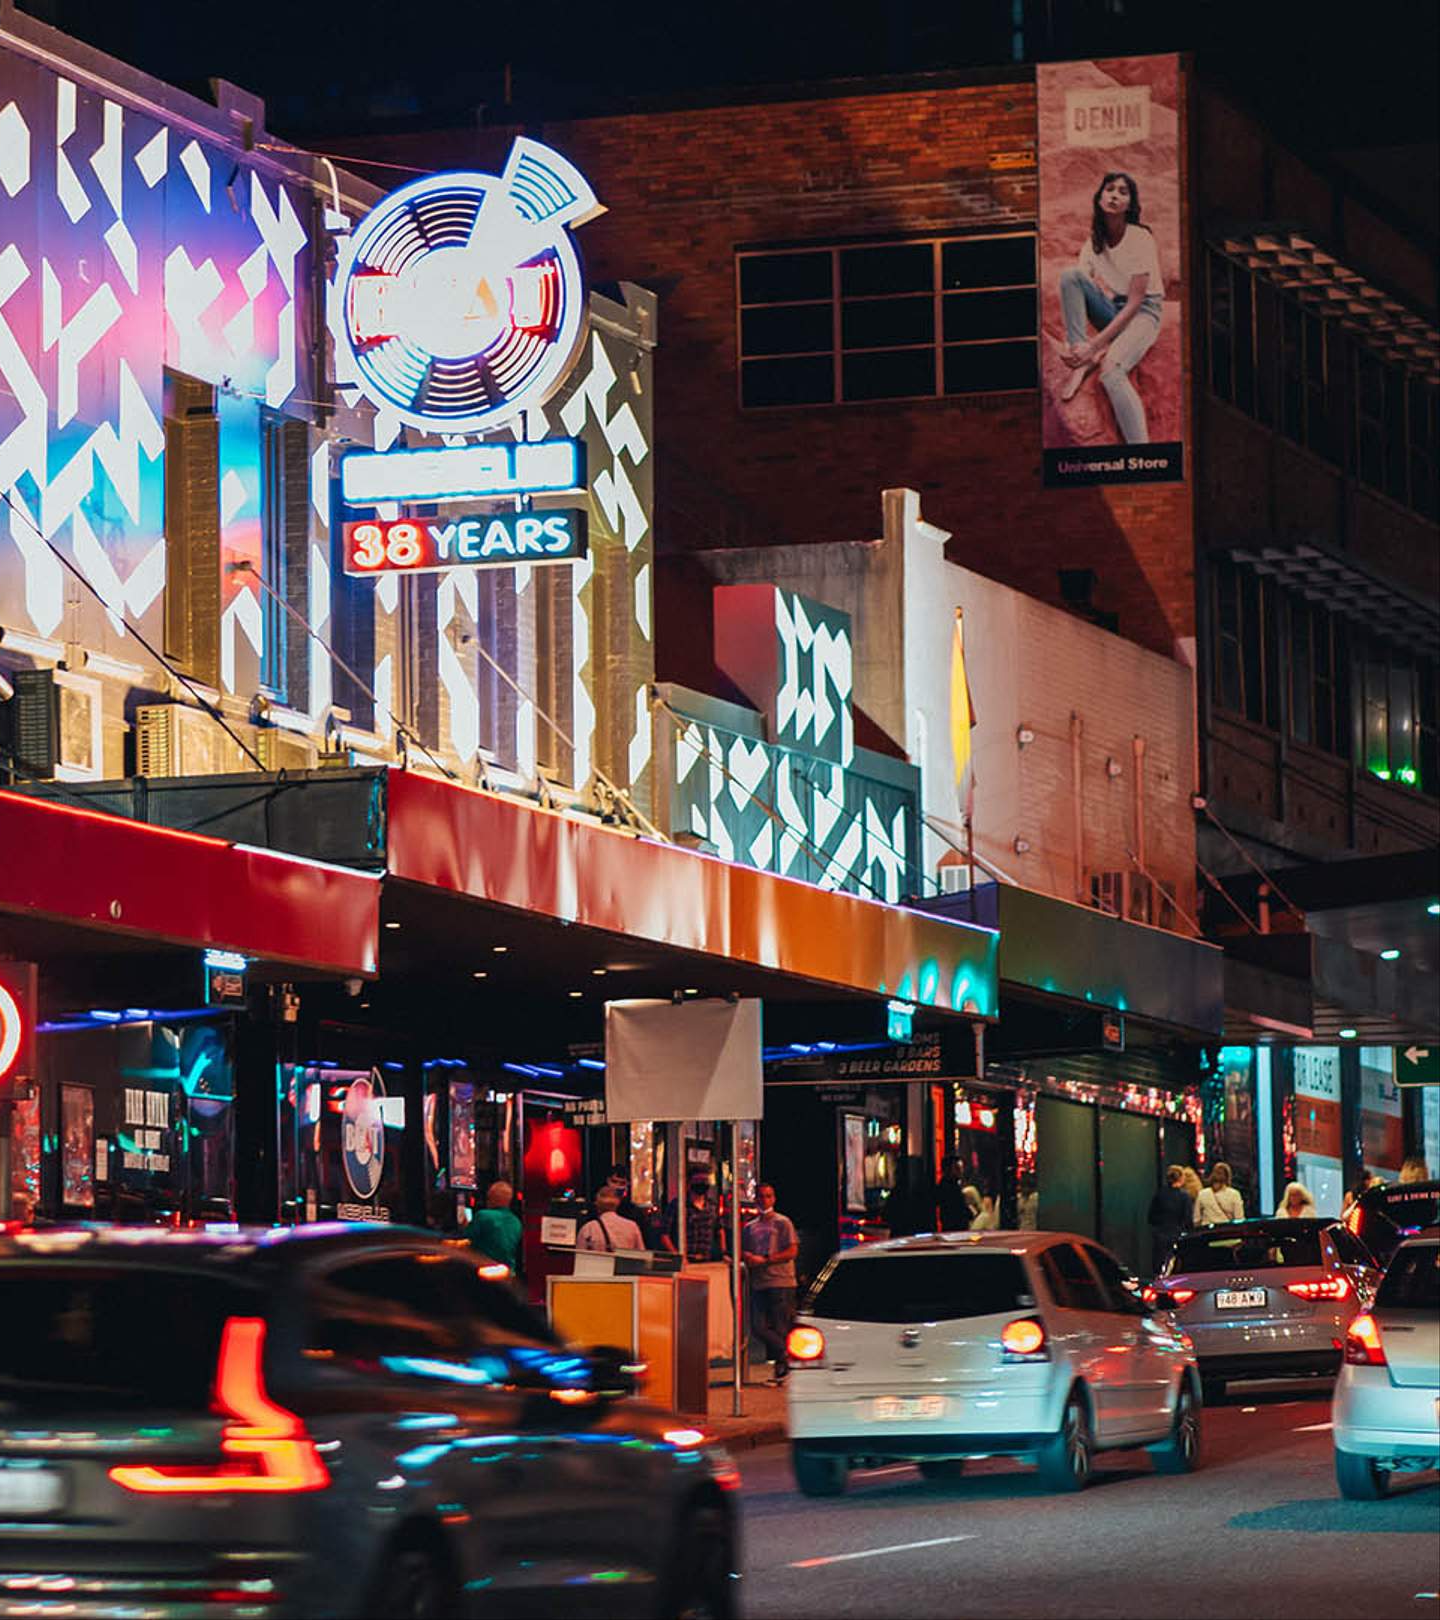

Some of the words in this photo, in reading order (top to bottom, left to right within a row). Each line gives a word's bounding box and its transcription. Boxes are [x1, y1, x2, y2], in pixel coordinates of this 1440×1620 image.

[1073, 103, 1142, 132] DENIM
[1058, 458, 1125, 473] Universal
[1127, 456, 1169, 471] Store
[352, 524, 422, 568] 38
[428, 516, 572, 560] YEARS
[849, 1061, 882, 1074] BEER
[883, 1060, 942, 1073] GARDENS
